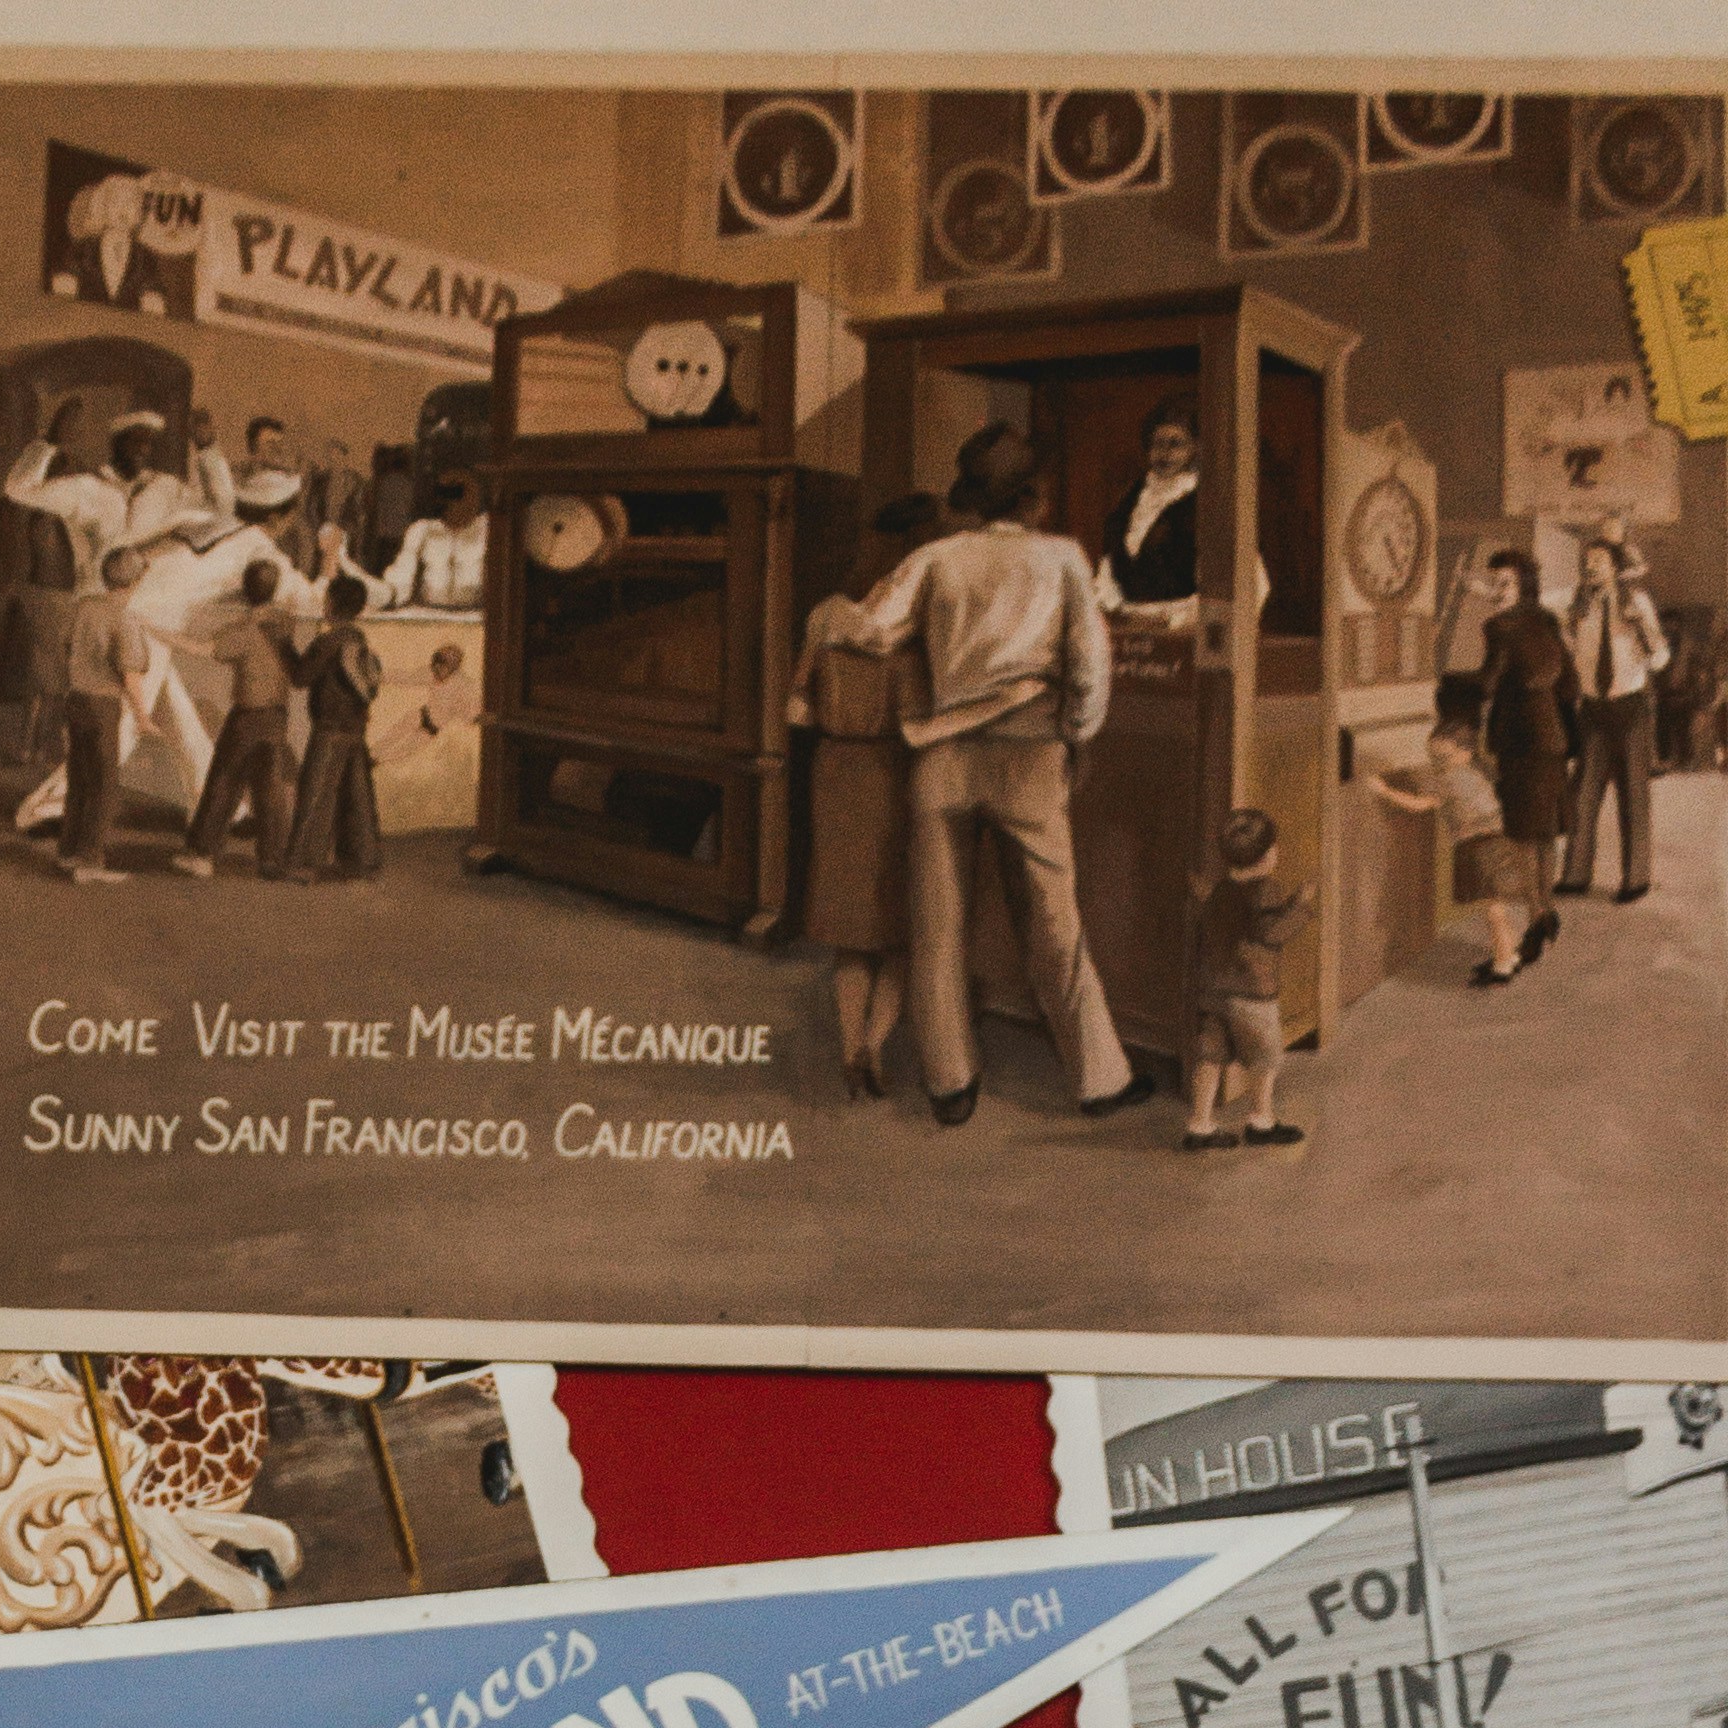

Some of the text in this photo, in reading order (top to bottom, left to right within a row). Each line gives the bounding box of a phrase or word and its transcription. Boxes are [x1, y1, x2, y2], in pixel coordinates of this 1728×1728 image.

[233, 213, 520, 327] PLAYLAND
[27, 998, 161, 1058] COME
[192, 999, 304, 1059] VISIT
[324, 1017, 393, 1061] THE
[23, 1094, 182, 1155] SUNNY
[194, 1095, 290, 1157] SAN
[553, 1102, 796, 1162] CALIFORNIA
[1194, 1401, 1432, 1501] HOUSE
[784, 1586, 1067, 1720] AT-THE-BEACH
